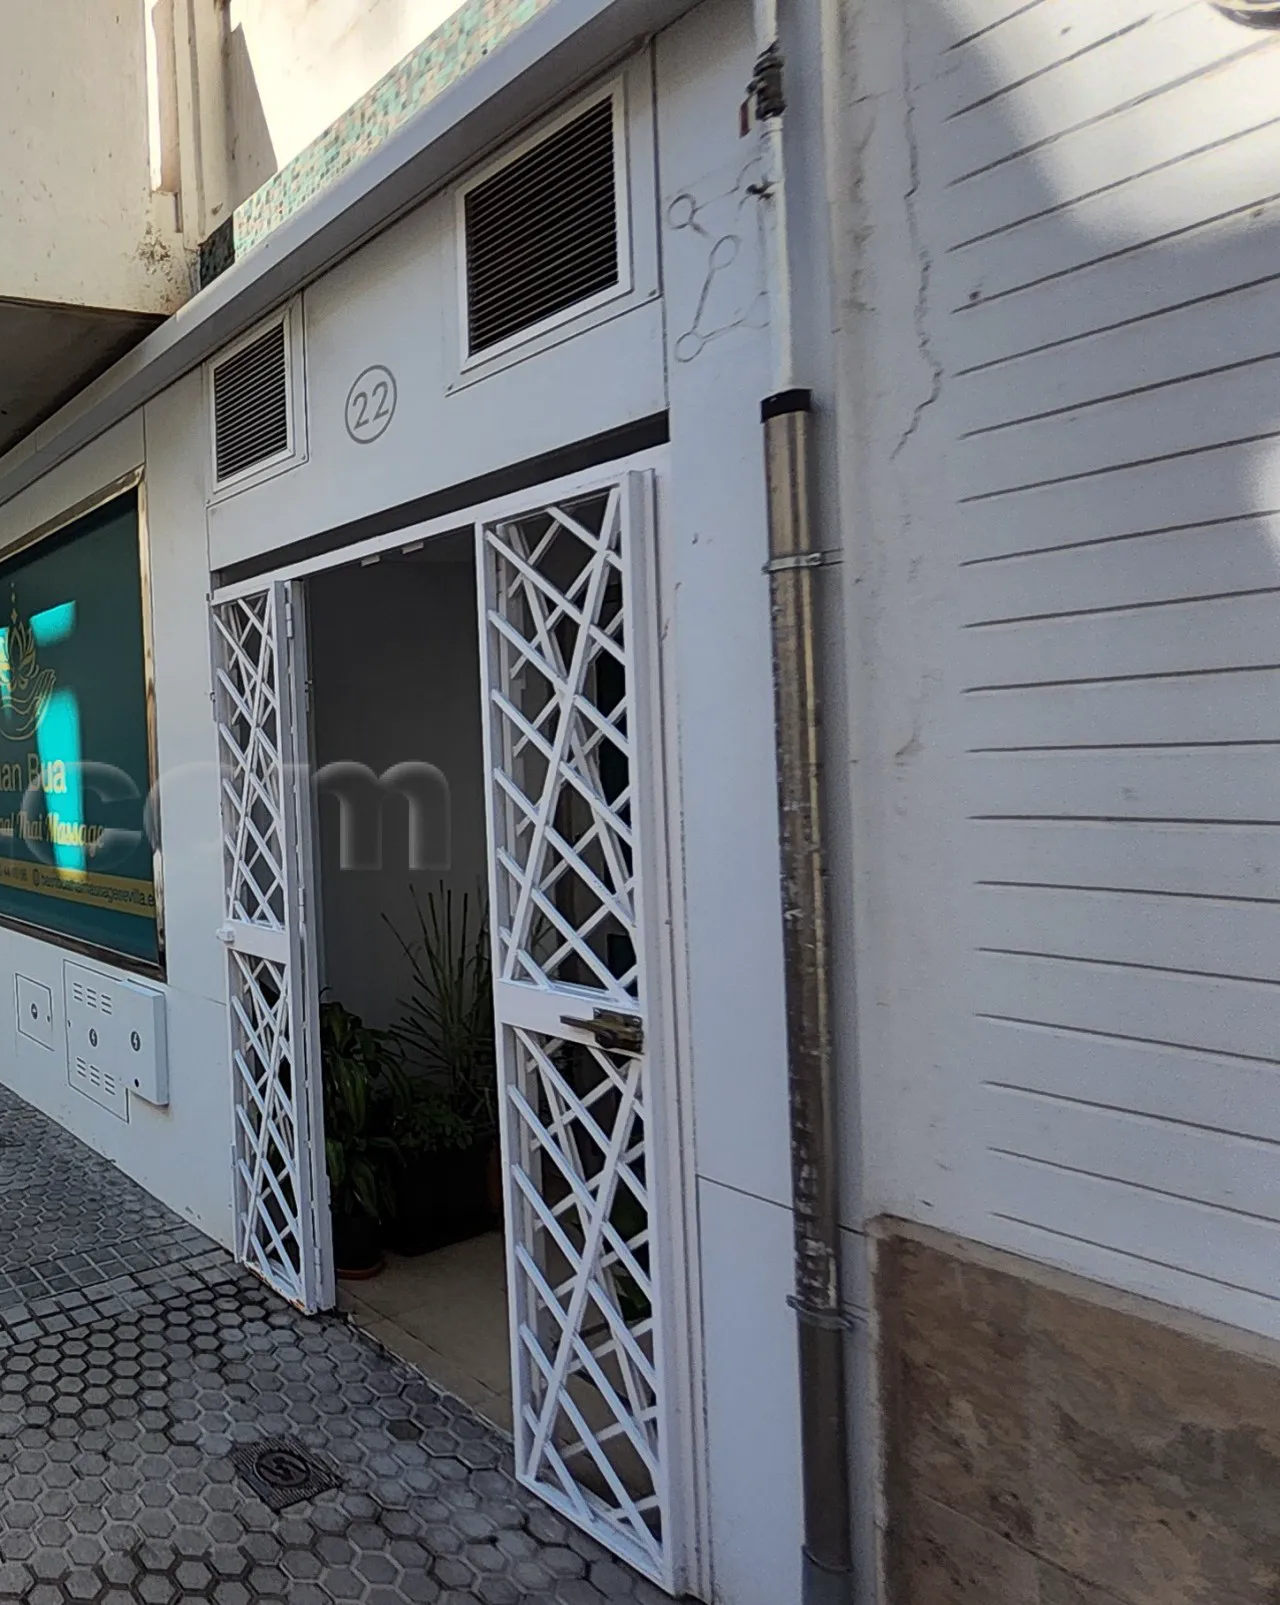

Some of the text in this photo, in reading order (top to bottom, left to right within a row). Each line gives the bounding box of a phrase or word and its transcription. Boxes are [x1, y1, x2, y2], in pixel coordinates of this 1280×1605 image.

[352, 380, 390, 431] 22
[26, 752, 68, 794] Bua
[16, 810, 43, 841] Thai
[45, 811, 106, 858] Massage
